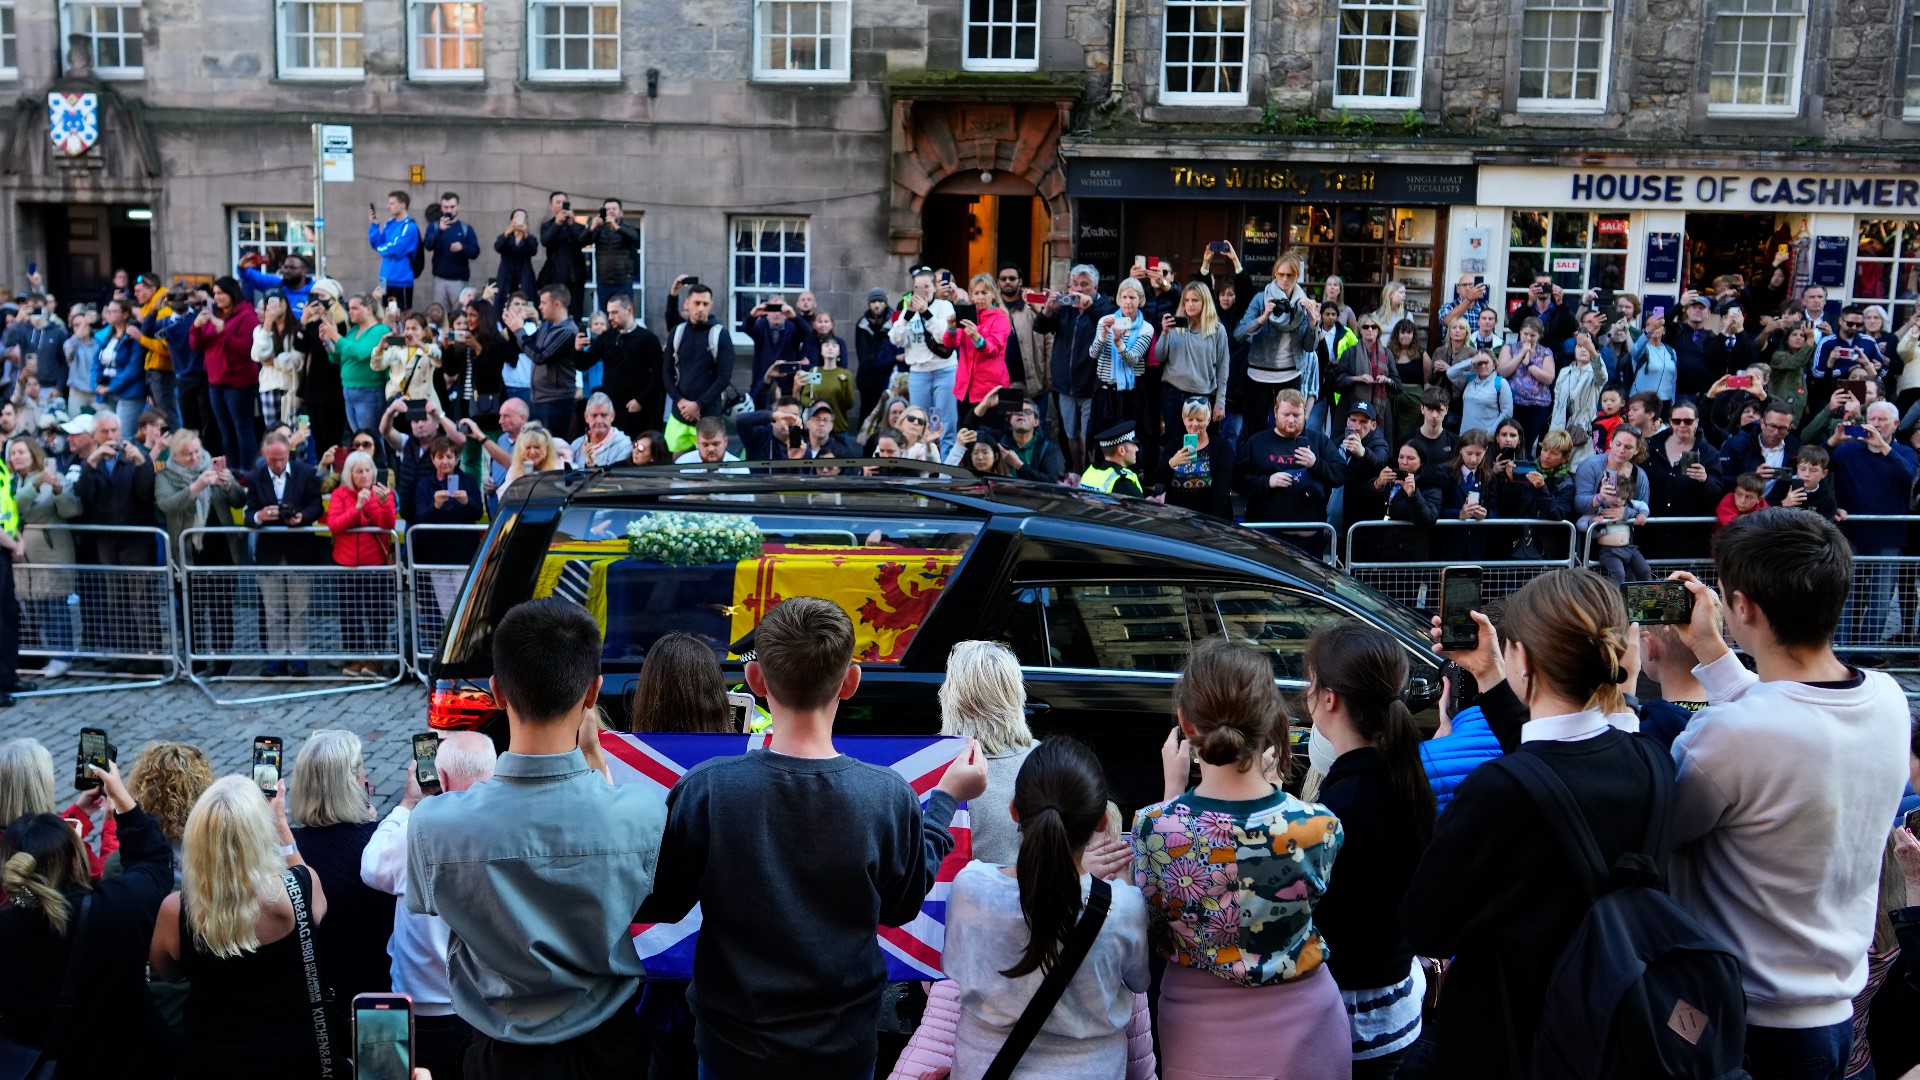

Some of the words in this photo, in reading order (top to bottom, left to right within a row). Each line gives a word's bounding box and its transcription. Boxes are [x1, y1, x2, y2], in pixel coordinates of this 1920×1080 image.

[1080, 179, 1122, 187] WHISKIES
[1170, 166, 1217, 188] The
[1223, 167, 1311, 195] Whisky
[1319, 168, 1376, 191] Trail
[1406, 175, 1438, 184] SINGLE
[1439, 175, 1464, 185] MALT
[1408, 184, 1460, 193] SPECIALISTS
[1571, 174, 1685, 202] HOUSE
[1696, 176, 1739, 203] OF
[1600, 222, 1624, 231] SALE
[1555, 261, 1578, 270] SALE
